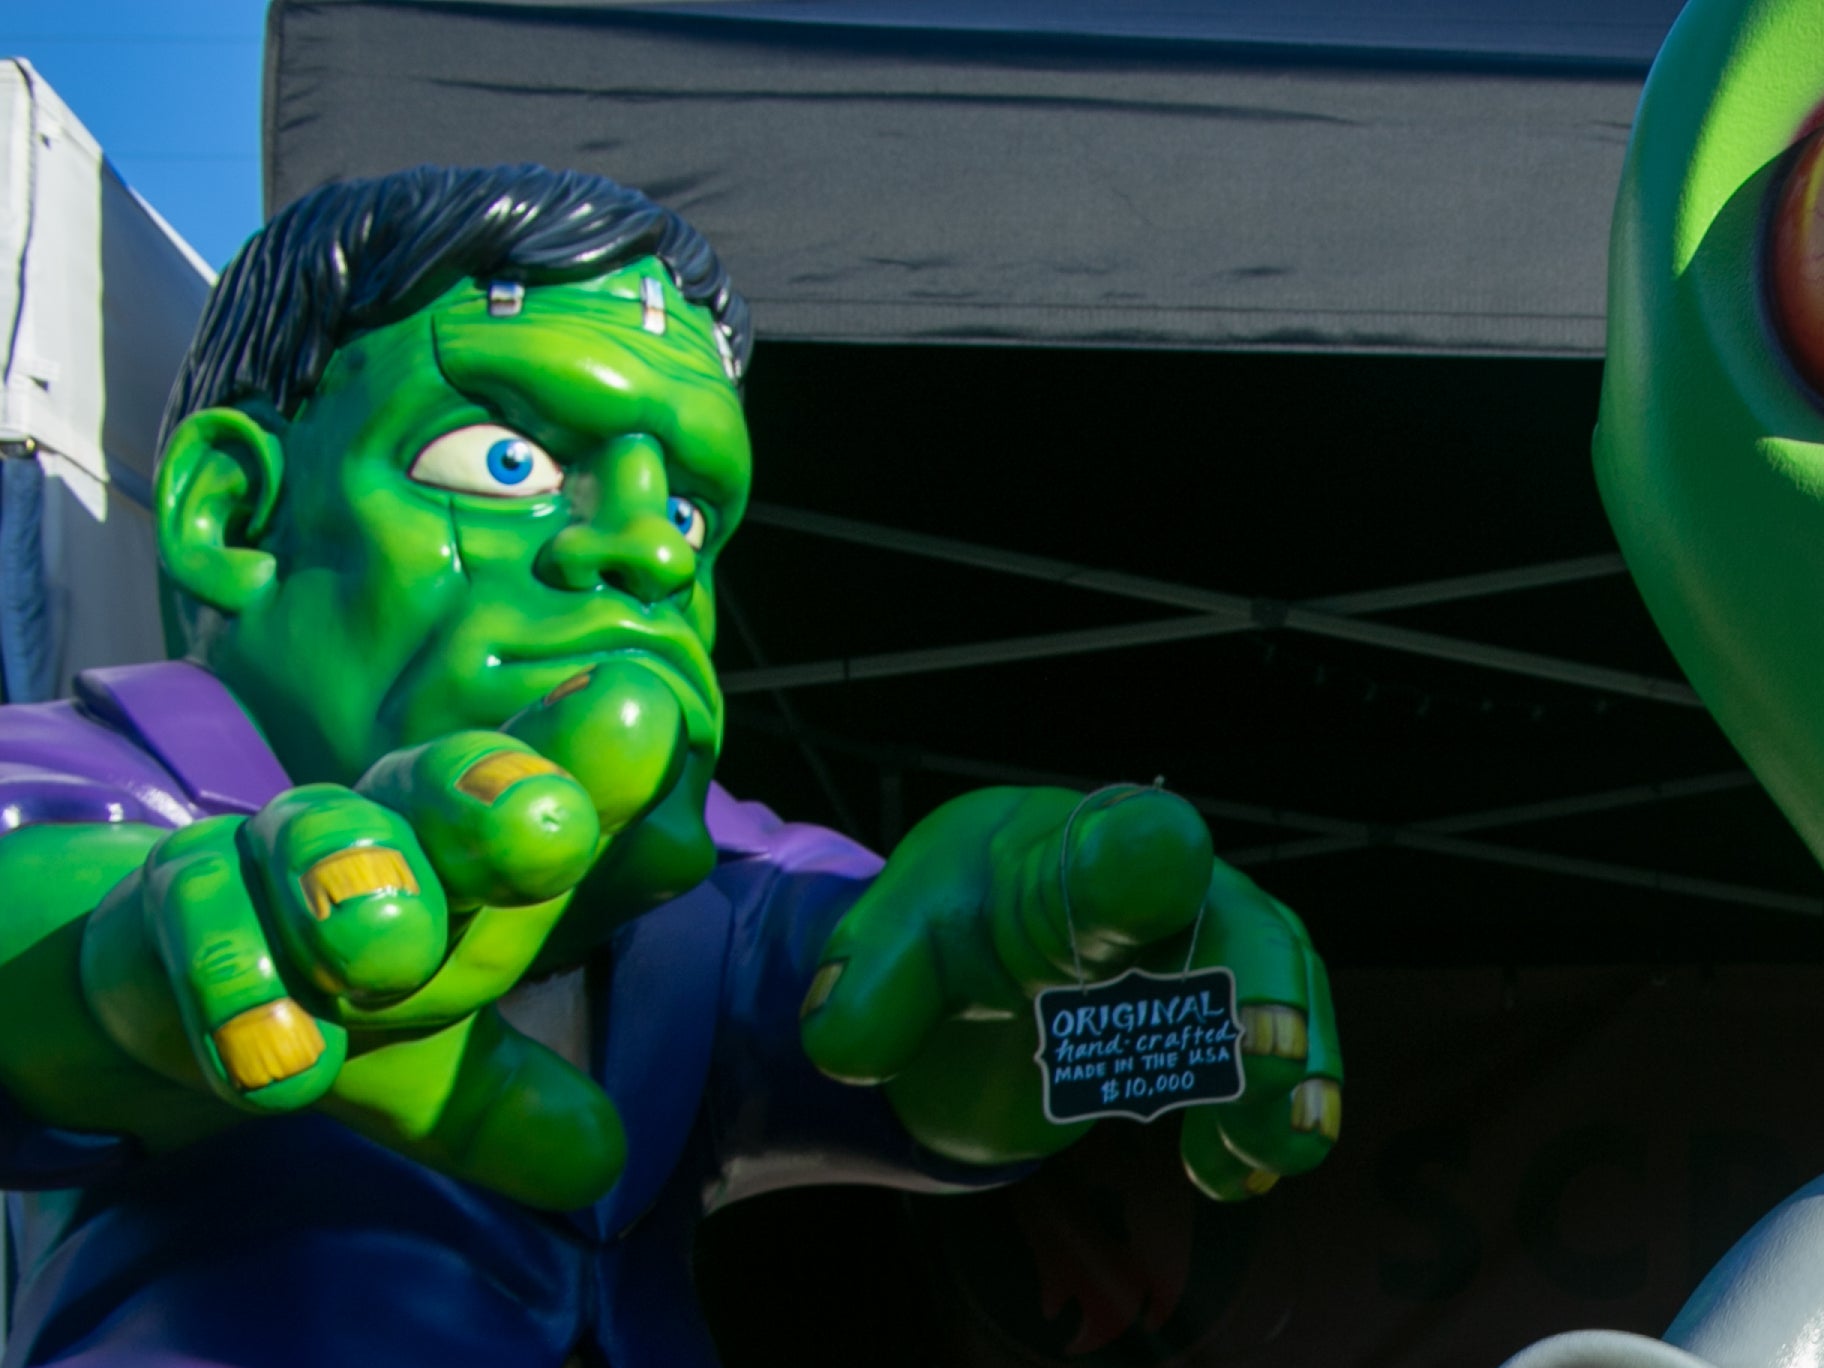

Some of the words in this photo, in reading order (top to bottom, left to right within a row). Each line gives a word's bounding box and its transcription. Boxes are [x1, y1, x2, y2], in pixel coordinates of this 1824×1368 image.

[1052, 991, 1225, 1037] ORIGINAL
[1055, 1020, 1236, 1062] hand-crafted
[1054, 1062, 1105, 1084] MADE
[1114, 1056, 1134, 1075] IN
[1141, 1051, 1178, 1071] THE
[1189, 1047, 1230, 1066] USA
